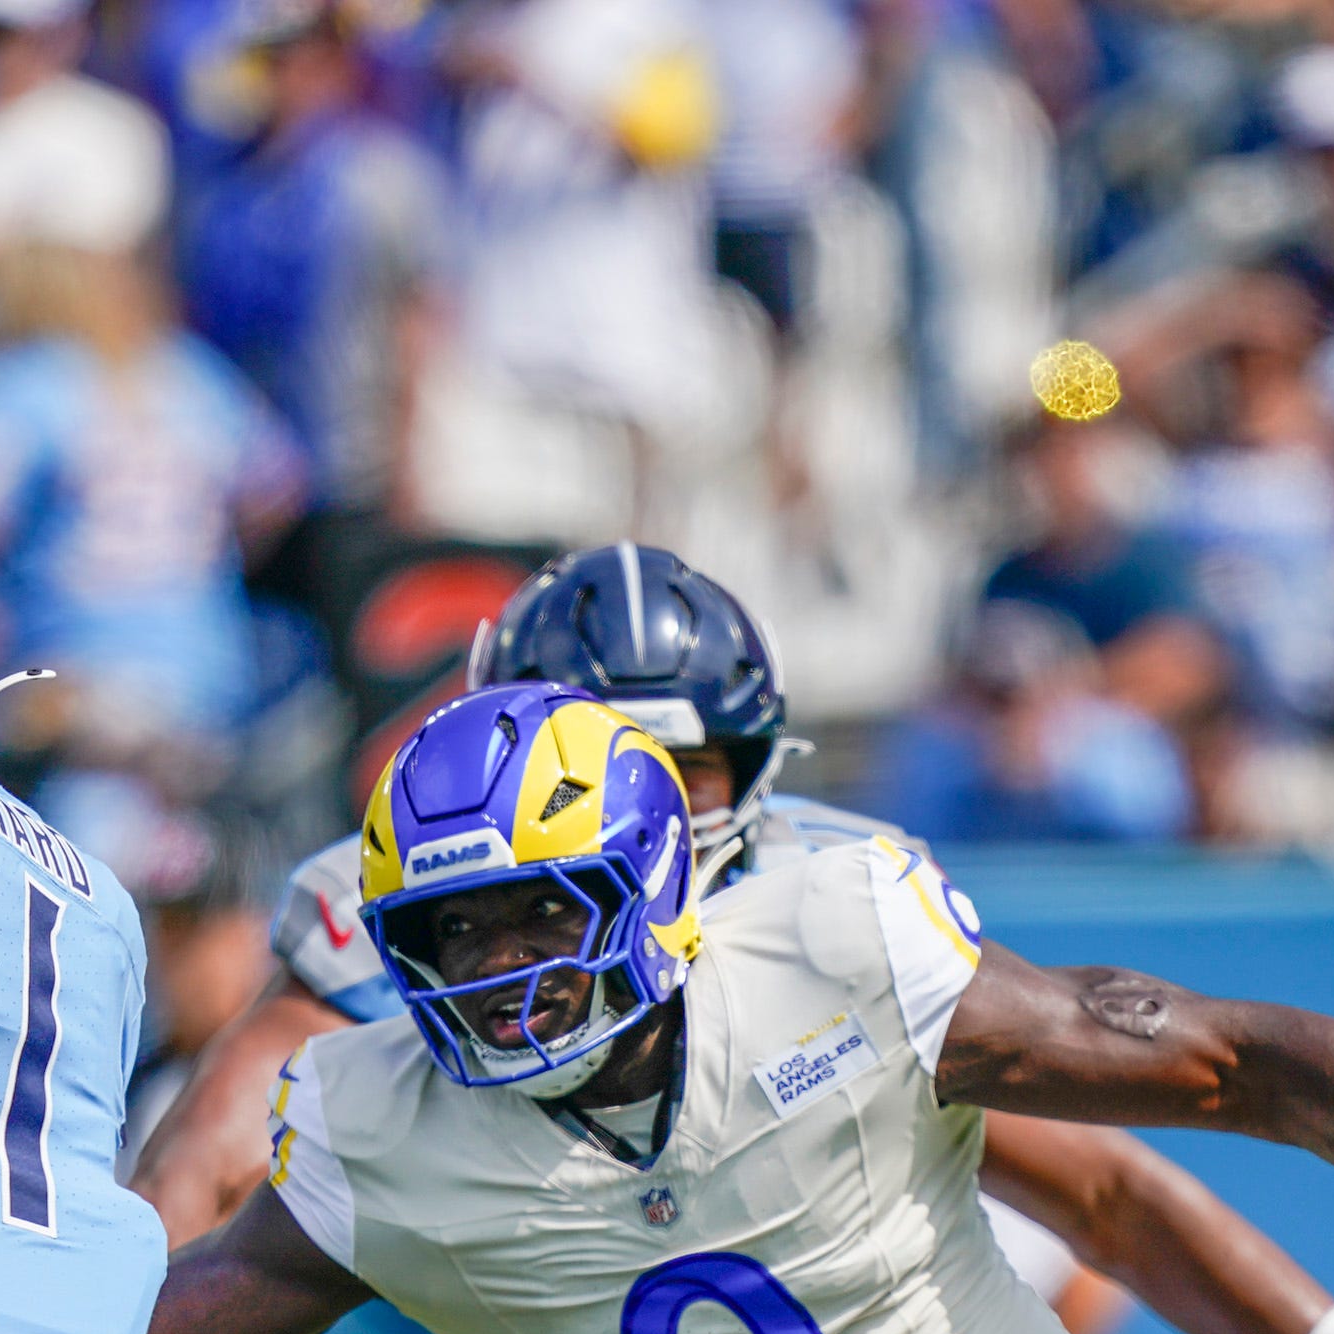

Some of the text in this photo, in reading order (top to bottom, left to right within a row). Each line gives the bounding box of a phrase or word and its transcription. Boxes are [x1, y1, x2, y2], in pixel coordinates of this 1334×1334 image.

[412, 841, 491, 874] RAMS
[767, 1053, 806, 1082] LOS
[777, 1034, 863, 1093] ANGELES
[781, 1065, 836, 1105] RAMS
[644, 1200, 678, 1225] NFL
